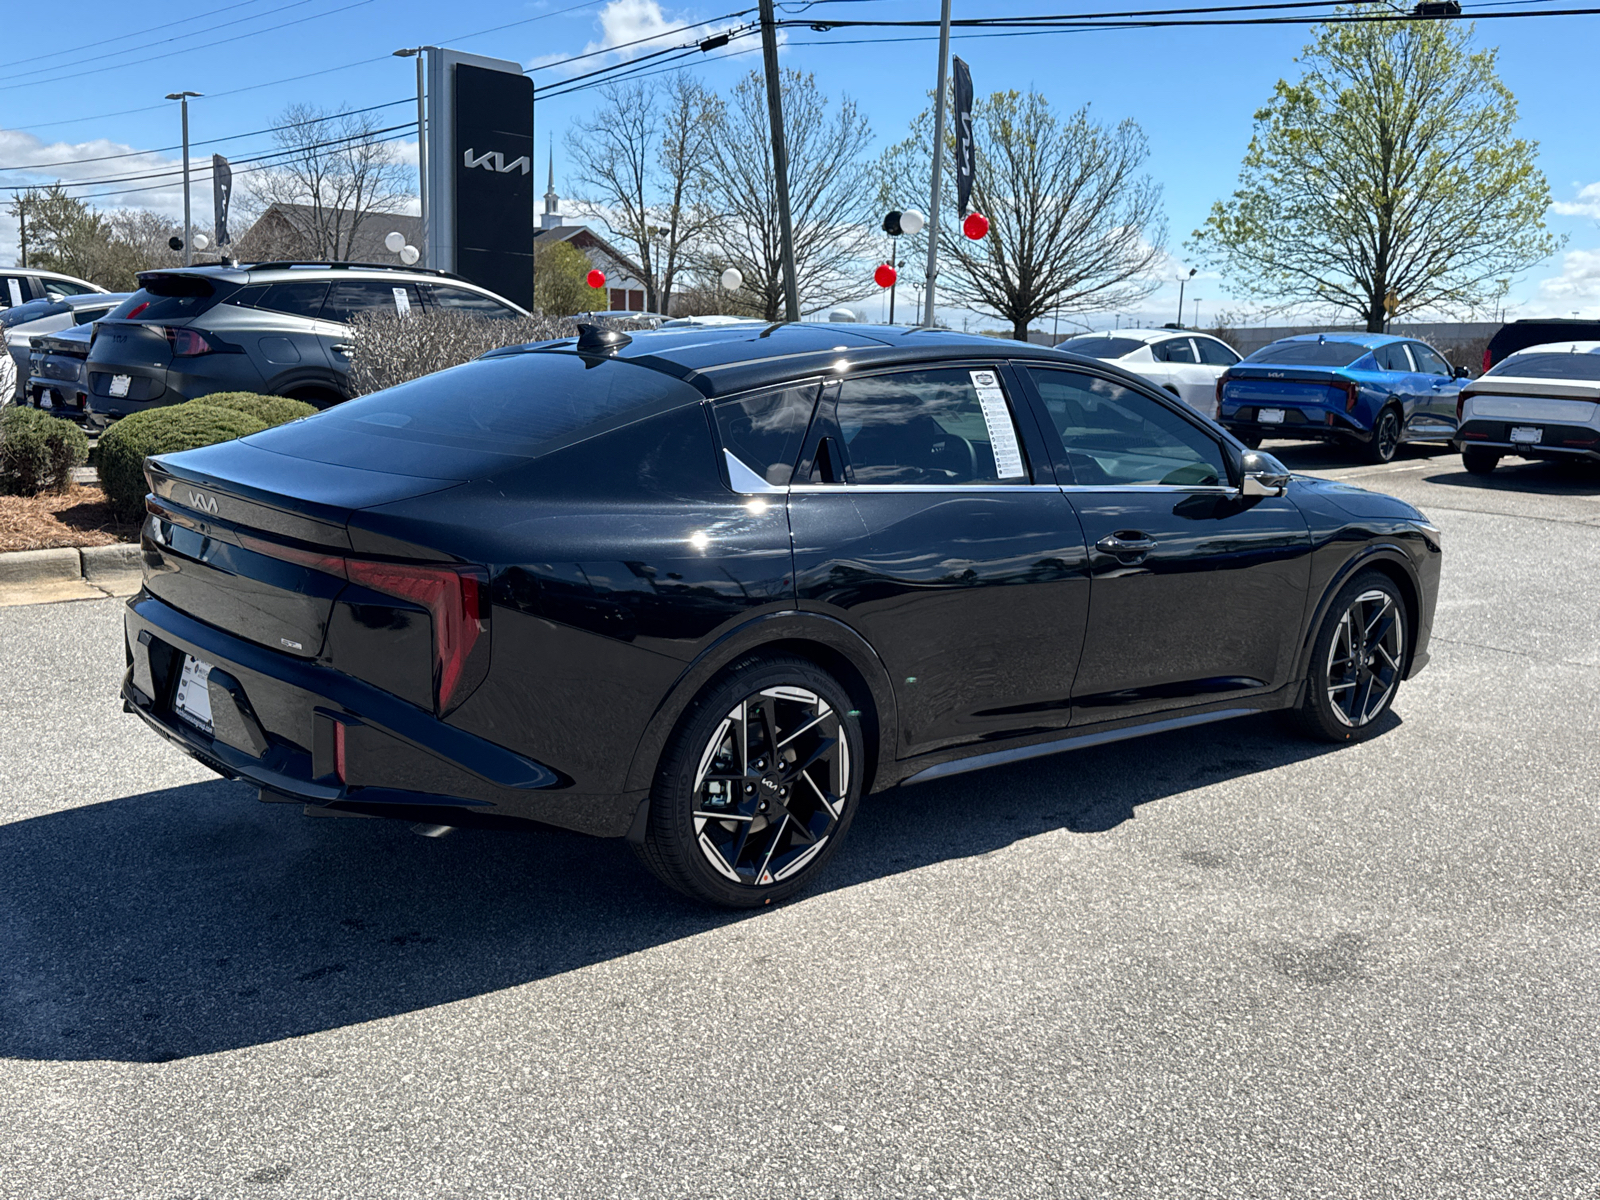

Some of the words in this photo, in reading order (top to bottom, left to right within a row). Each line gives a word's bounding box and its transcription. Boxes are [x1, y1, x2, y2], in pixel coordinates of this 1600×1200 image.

[464, 147, 530, 176] KIA
[188, 490, 220, 514] KIA
[761, 777, 778, 791] KIA
[677, 773, 689, 839] KUMHO
